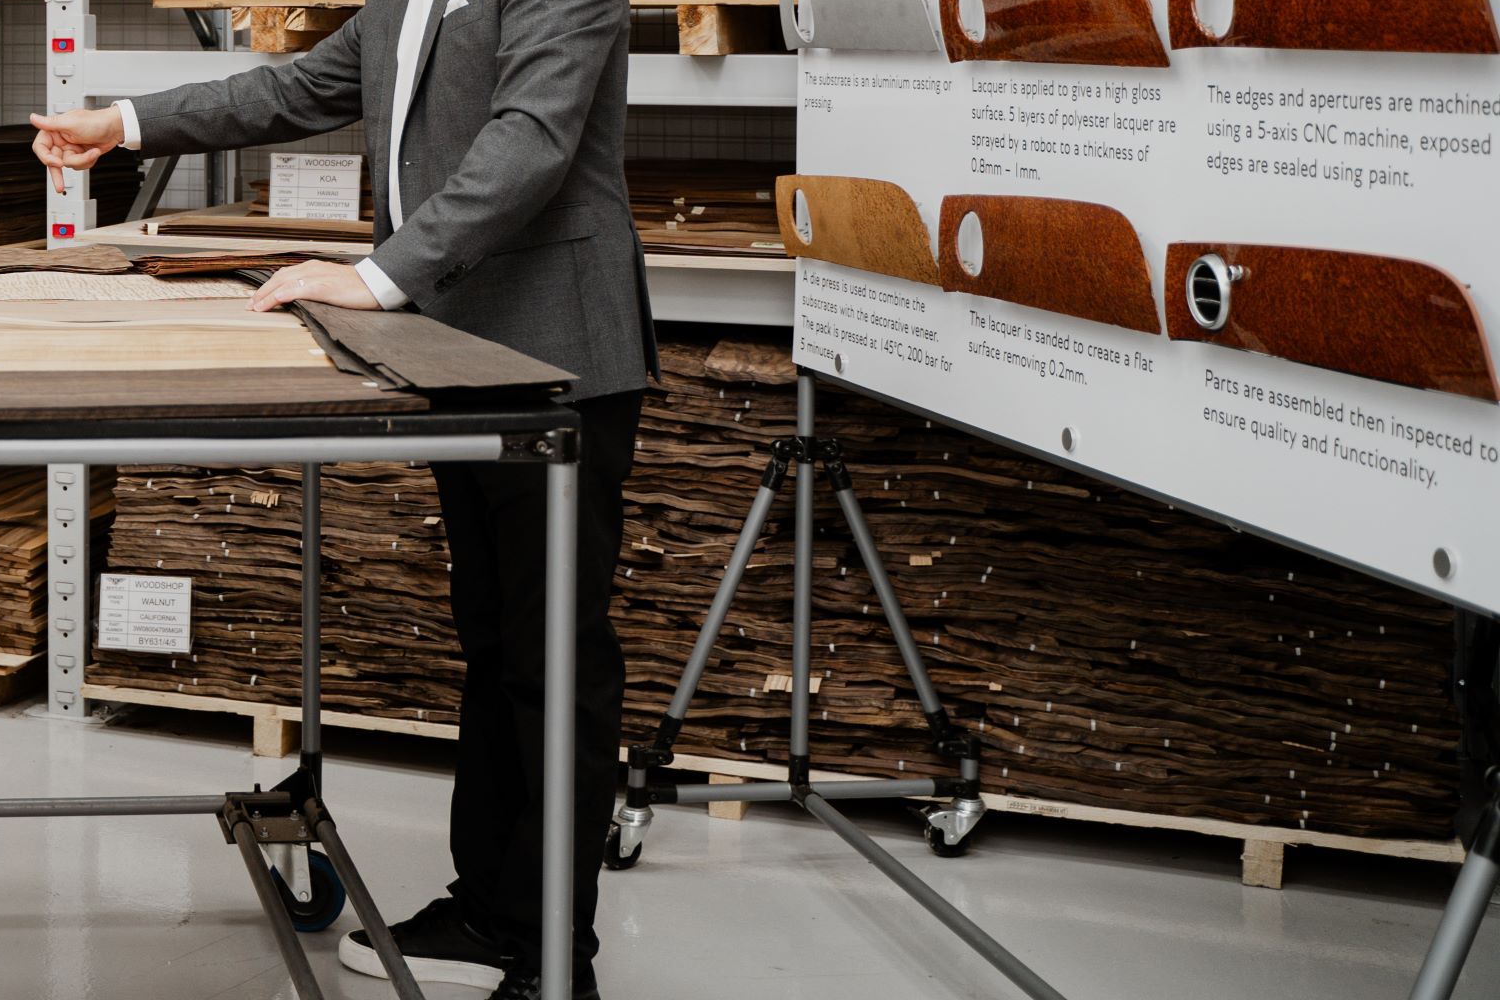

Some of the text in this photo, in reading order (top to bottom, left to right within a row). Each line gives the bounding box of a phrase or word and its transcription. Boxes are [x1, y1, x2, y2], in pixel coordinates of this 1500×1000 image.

[805, 96, 833, 112] pressing.
[972, 78, 1160, 104] Lacquer is applied to give a high gloss
[1207, 85, 1500, 116] The edges and apertures are machined
[972, 105, 1176, 135] surface. 5 layers of polyester lacquer are
[1207, 119, 1491, 158] using a 5-axis CNC machine, exposed
[971, 158, 1002, 175] 0.8mm
[1016, 163, 1041, 180] 1mm.
[1207, 152, 1413, 189] edges are sealed using paint.
[800, 337, 834, 360] 5 minutes
[801, 315, 814, 330] The
[816, 322, 831, 337] pack
[834, 324, 839, 337] is
[841, 329, 867, 347] pressed
[870, 339, 877, 350] at
[908, 346, 922, 363] 200
[925, 351, 938, 368] bar
[940, 356, 952, 372] for
[970, 310, 1153, 373] The lacquer is sanded to create a flat
[969, 340, 1087, 386] surface removing 0.2mm.
[1205, 369, 1499, 464] Parts are assembled then inspected to
[1204, 405, 1437, 489] ensure quality and functionality.
[135, 581, 183, 589] WOODSHOP
[142, 598, 175, 606] WALNUT
